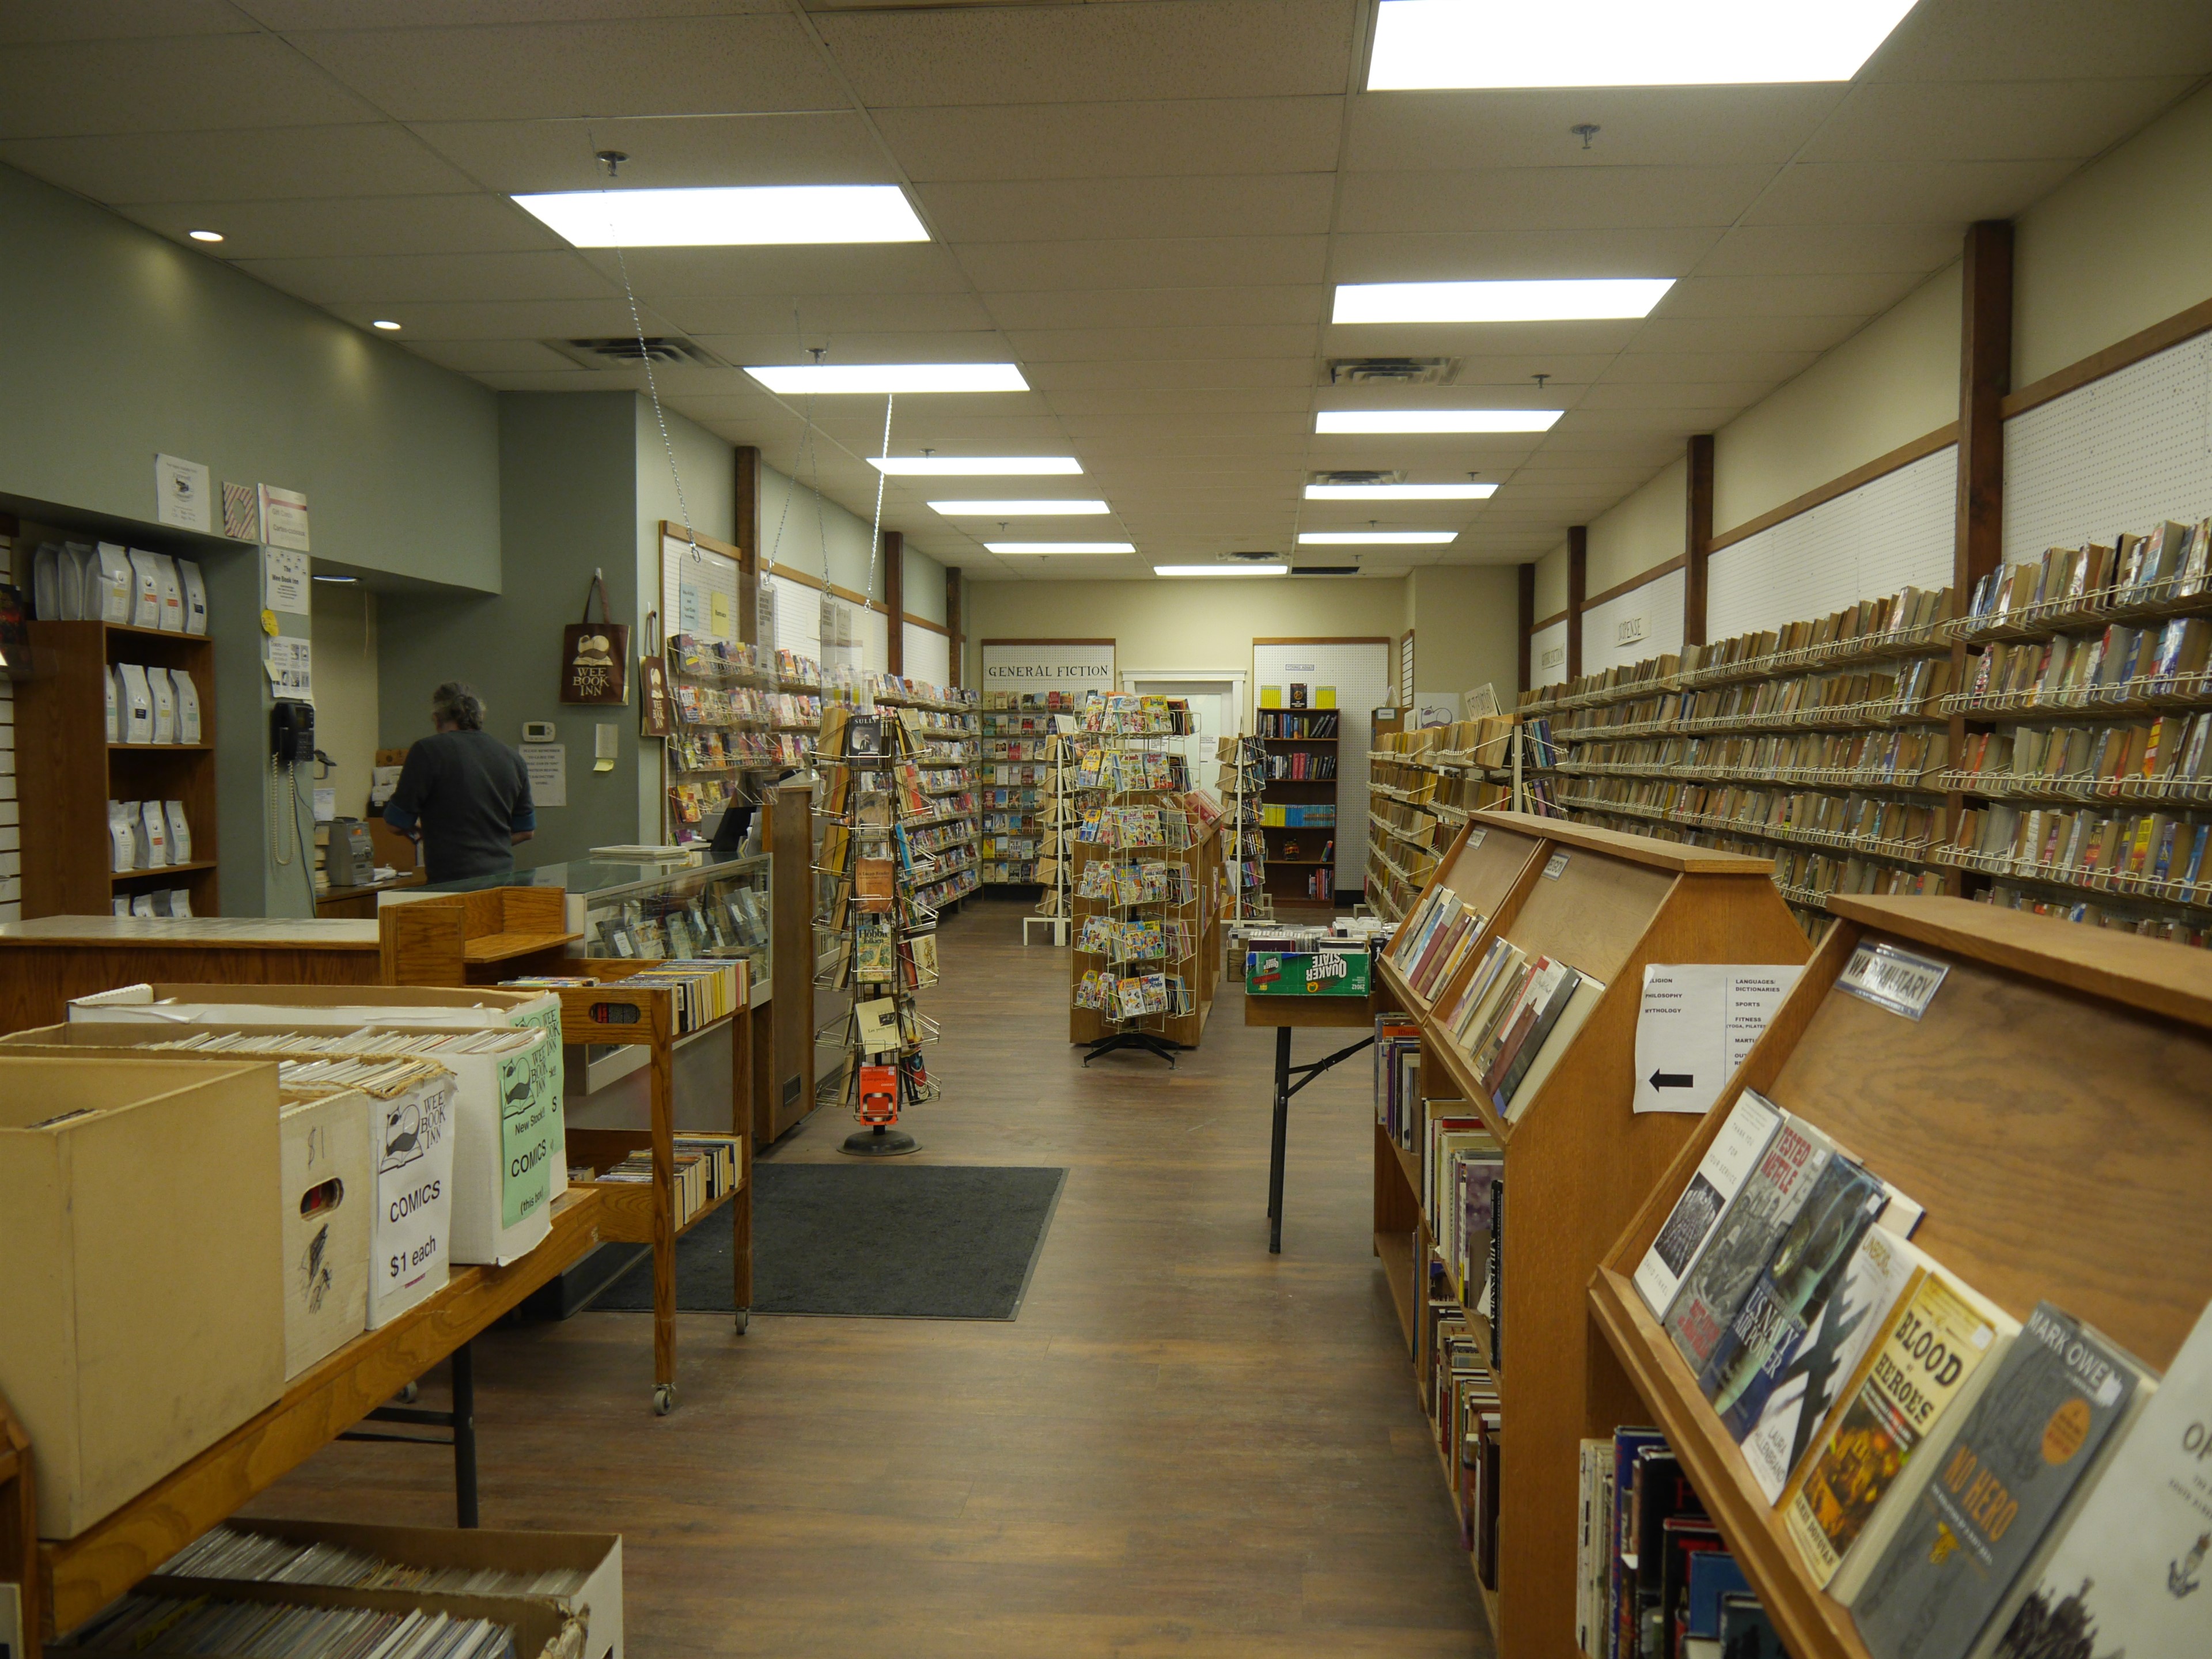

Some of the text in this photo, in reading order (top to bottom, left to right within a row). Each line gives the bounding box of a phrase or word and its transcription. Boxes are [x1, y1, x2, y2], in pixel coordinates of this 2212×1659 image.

[573, 676, 610, 687] BOOK
[576, 667, 607, 677] WEE
[988, 665, 1108, 677] GENERAL FICTION
[580, 685, 601, 696] INN
[653, 700, 662, 709] WEE
[653, 709, 664, 719] BOOK
[1305, 958, 1347, 982] QUAKER
[1312, 953, 1342, 968] STATE
[547, 1021, 560, 1039] OOK
[532, 1045, 546, 1066] WEE
[531, 1058, 548, 1084] BOOK
[536, 1077, 546, 1097] INN
[424, 1090, 445, 1115] WEE
[421, 1105, 446, 1134] BOOK
[515, 1120, 529, 1136] New
[427, 1124, 441, 1149] INN
[1776, 1126, 1812, 1168] TESTED
[512, 1139, 547, 1178] COMICS
[1761, 1150, 1798, 1195] METTLE
[390, 1180, 441, 1223] COMICS
[521, 1196, 534, 1215] (this
[391, 1234, 436, 1279] $1 each
[1758, 1303, 1800, 1356] NAVY
[1734, 1312, 1782, 1380] AIR POWER
[1895, 1309, 1963, 1388] BLOOD
[2027, 1310, 2071, 1356] MARK
[2065, 1340, 2120, 1388] OWE
[1874, 1352, 1935, 1425] HEROES
[1767, 1425, 1787, 1457] LAURA
[1943, 1444, 2018, 1543] NO HERO
